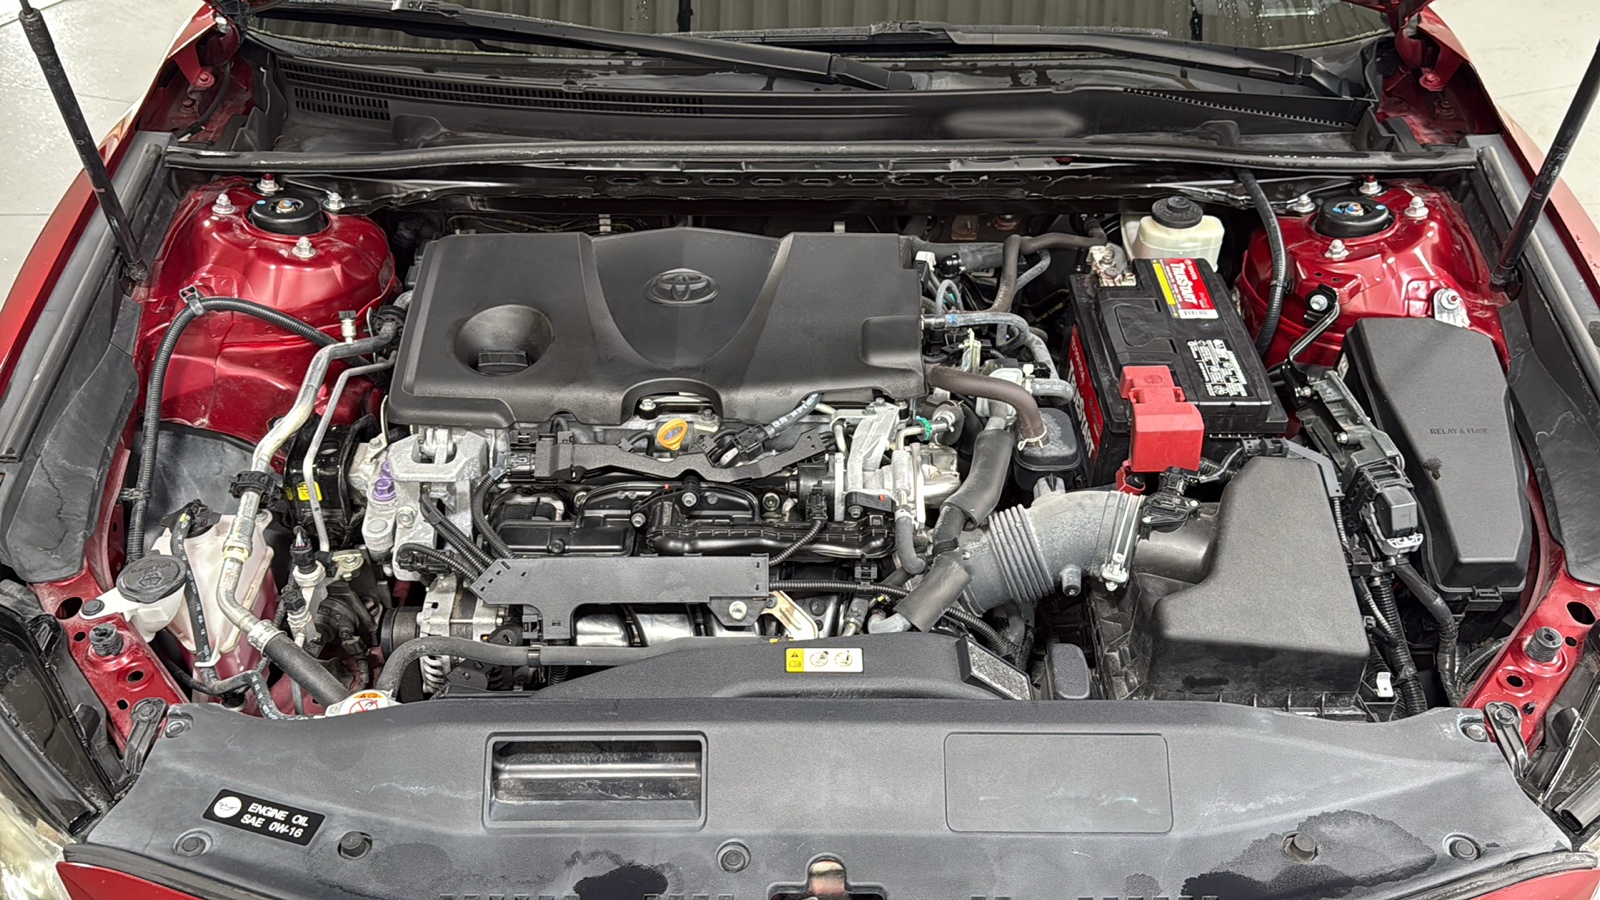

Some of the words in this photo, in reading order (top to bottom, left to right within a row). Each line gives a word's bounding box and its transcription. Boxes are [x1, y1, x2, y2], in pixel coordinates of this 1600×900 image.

[1429, 427, 1457, 435] RELAY
[240, 813, 266, 828] SAE
[268, 821, 304, 838] 0W-16
[247, 802, 289, 821] ENGINE
[291, 814, 309, 828] OIL
